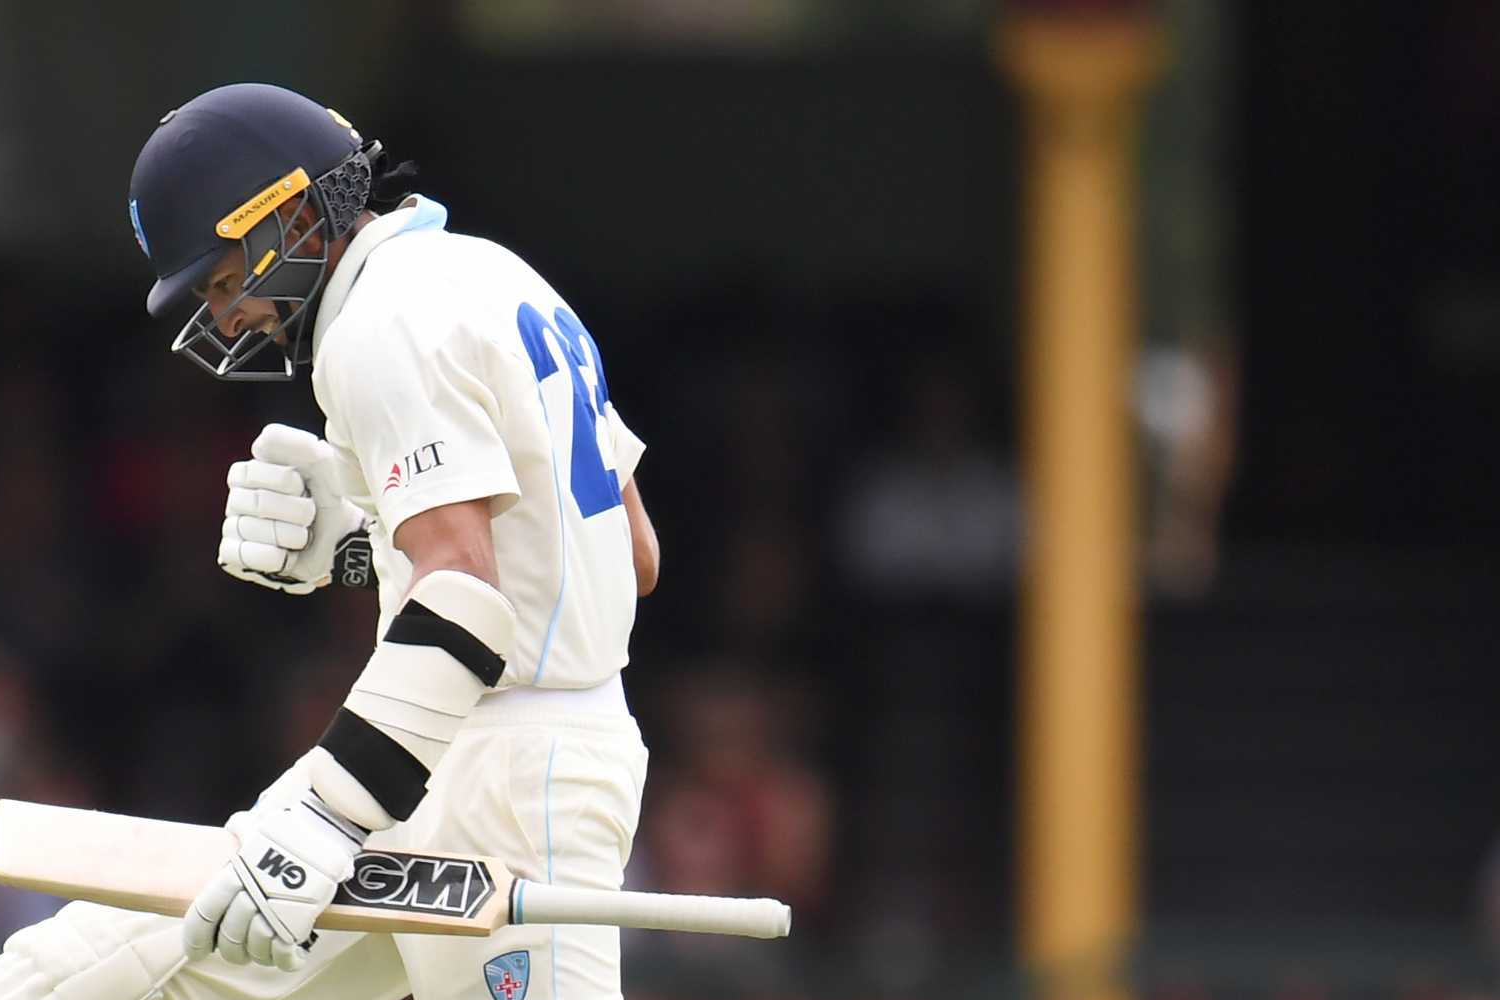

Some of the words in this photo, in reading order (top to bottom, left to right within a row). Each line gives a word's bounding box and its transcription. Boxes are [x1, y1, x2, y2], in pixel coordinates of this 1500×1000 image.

[233, 190, 280, 224] MASURI
[404, 440, 445, 488] JLT
[342, 547, 371, 587] GM
[256, 847, 307, 890] GM
[342, 852, 474, 912] GM
